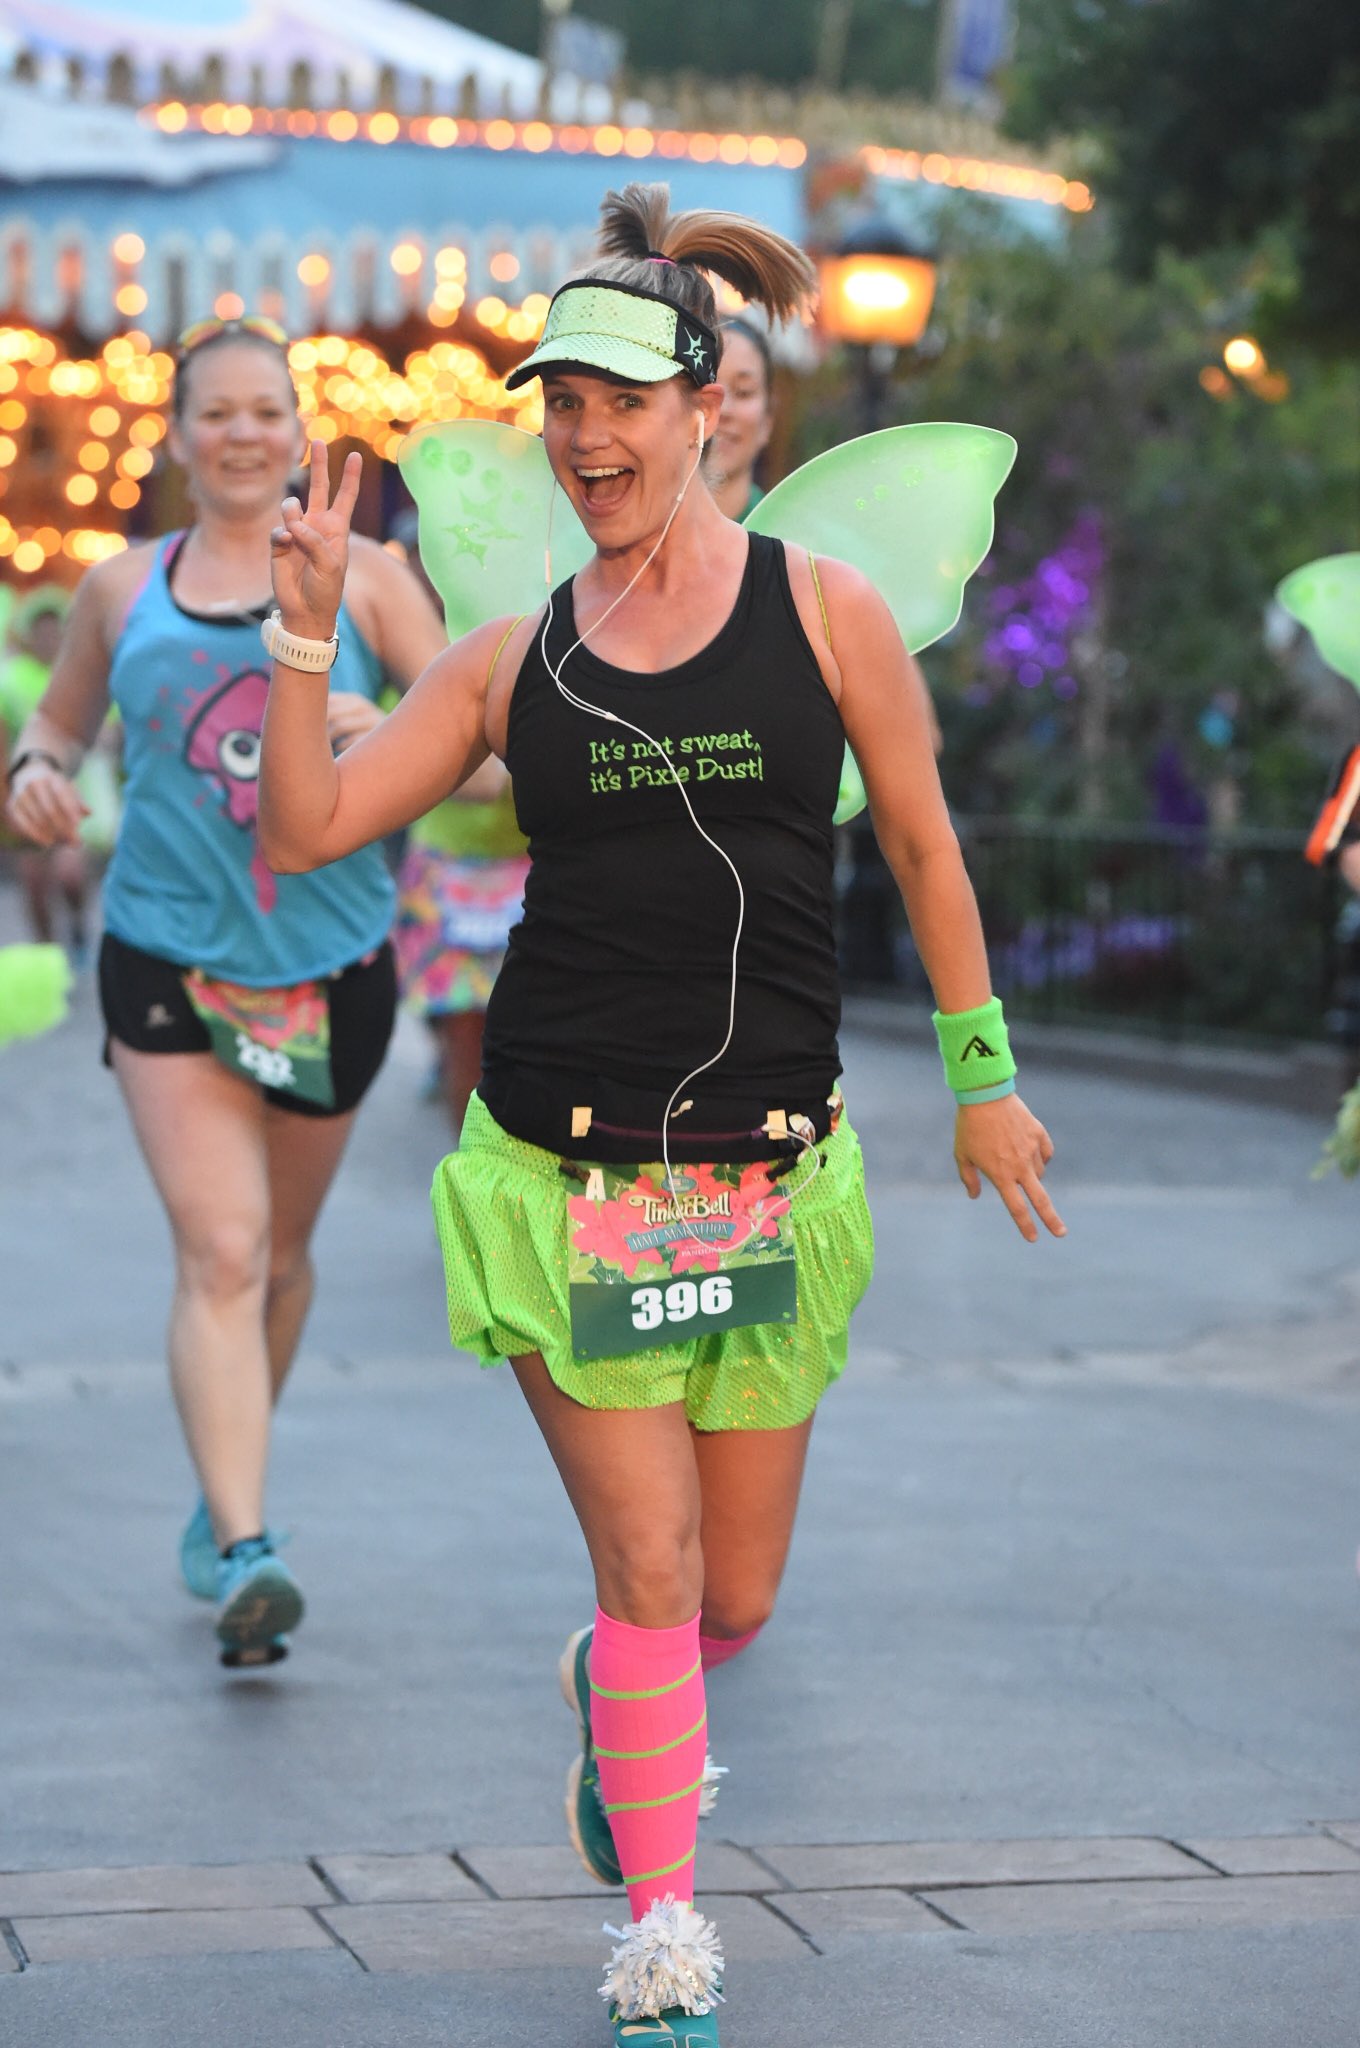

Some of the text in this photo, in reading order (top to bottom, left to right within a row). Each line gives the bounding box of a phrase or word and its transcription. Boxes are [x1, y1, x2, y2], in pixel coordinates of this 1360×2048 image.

[589, 729, 762, 764] It's not sweat,
[589, 767, 623, 793] it's
[695, 756, 763, 782] Dust!
[630, 1275, 734, 1331] 396
